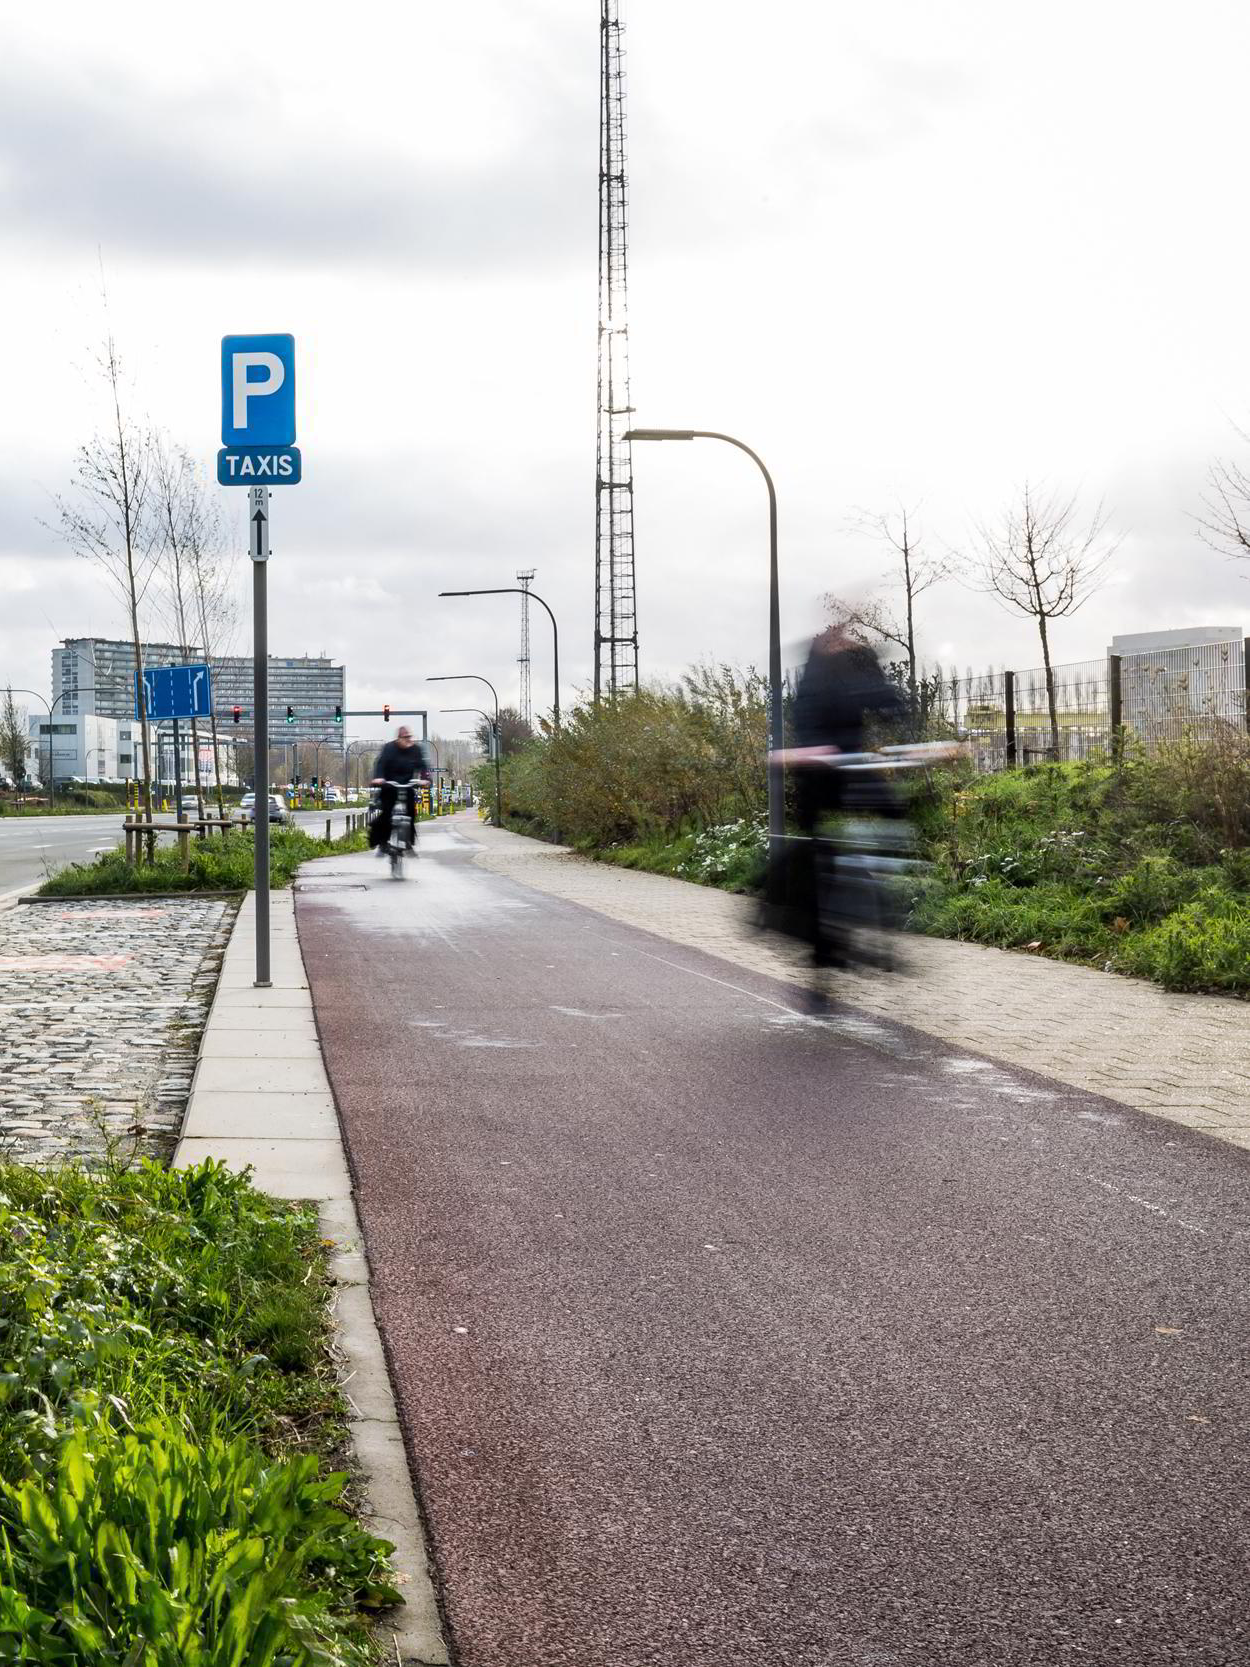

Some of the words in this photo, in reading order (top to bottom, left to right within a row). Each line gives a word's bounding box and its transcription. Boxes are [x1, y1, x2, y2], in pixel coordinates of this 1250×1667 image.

[232, 351, 285, 429] P
[225, 455, 293, 476] TAXIS
[254, 488, 263, 499] 12
